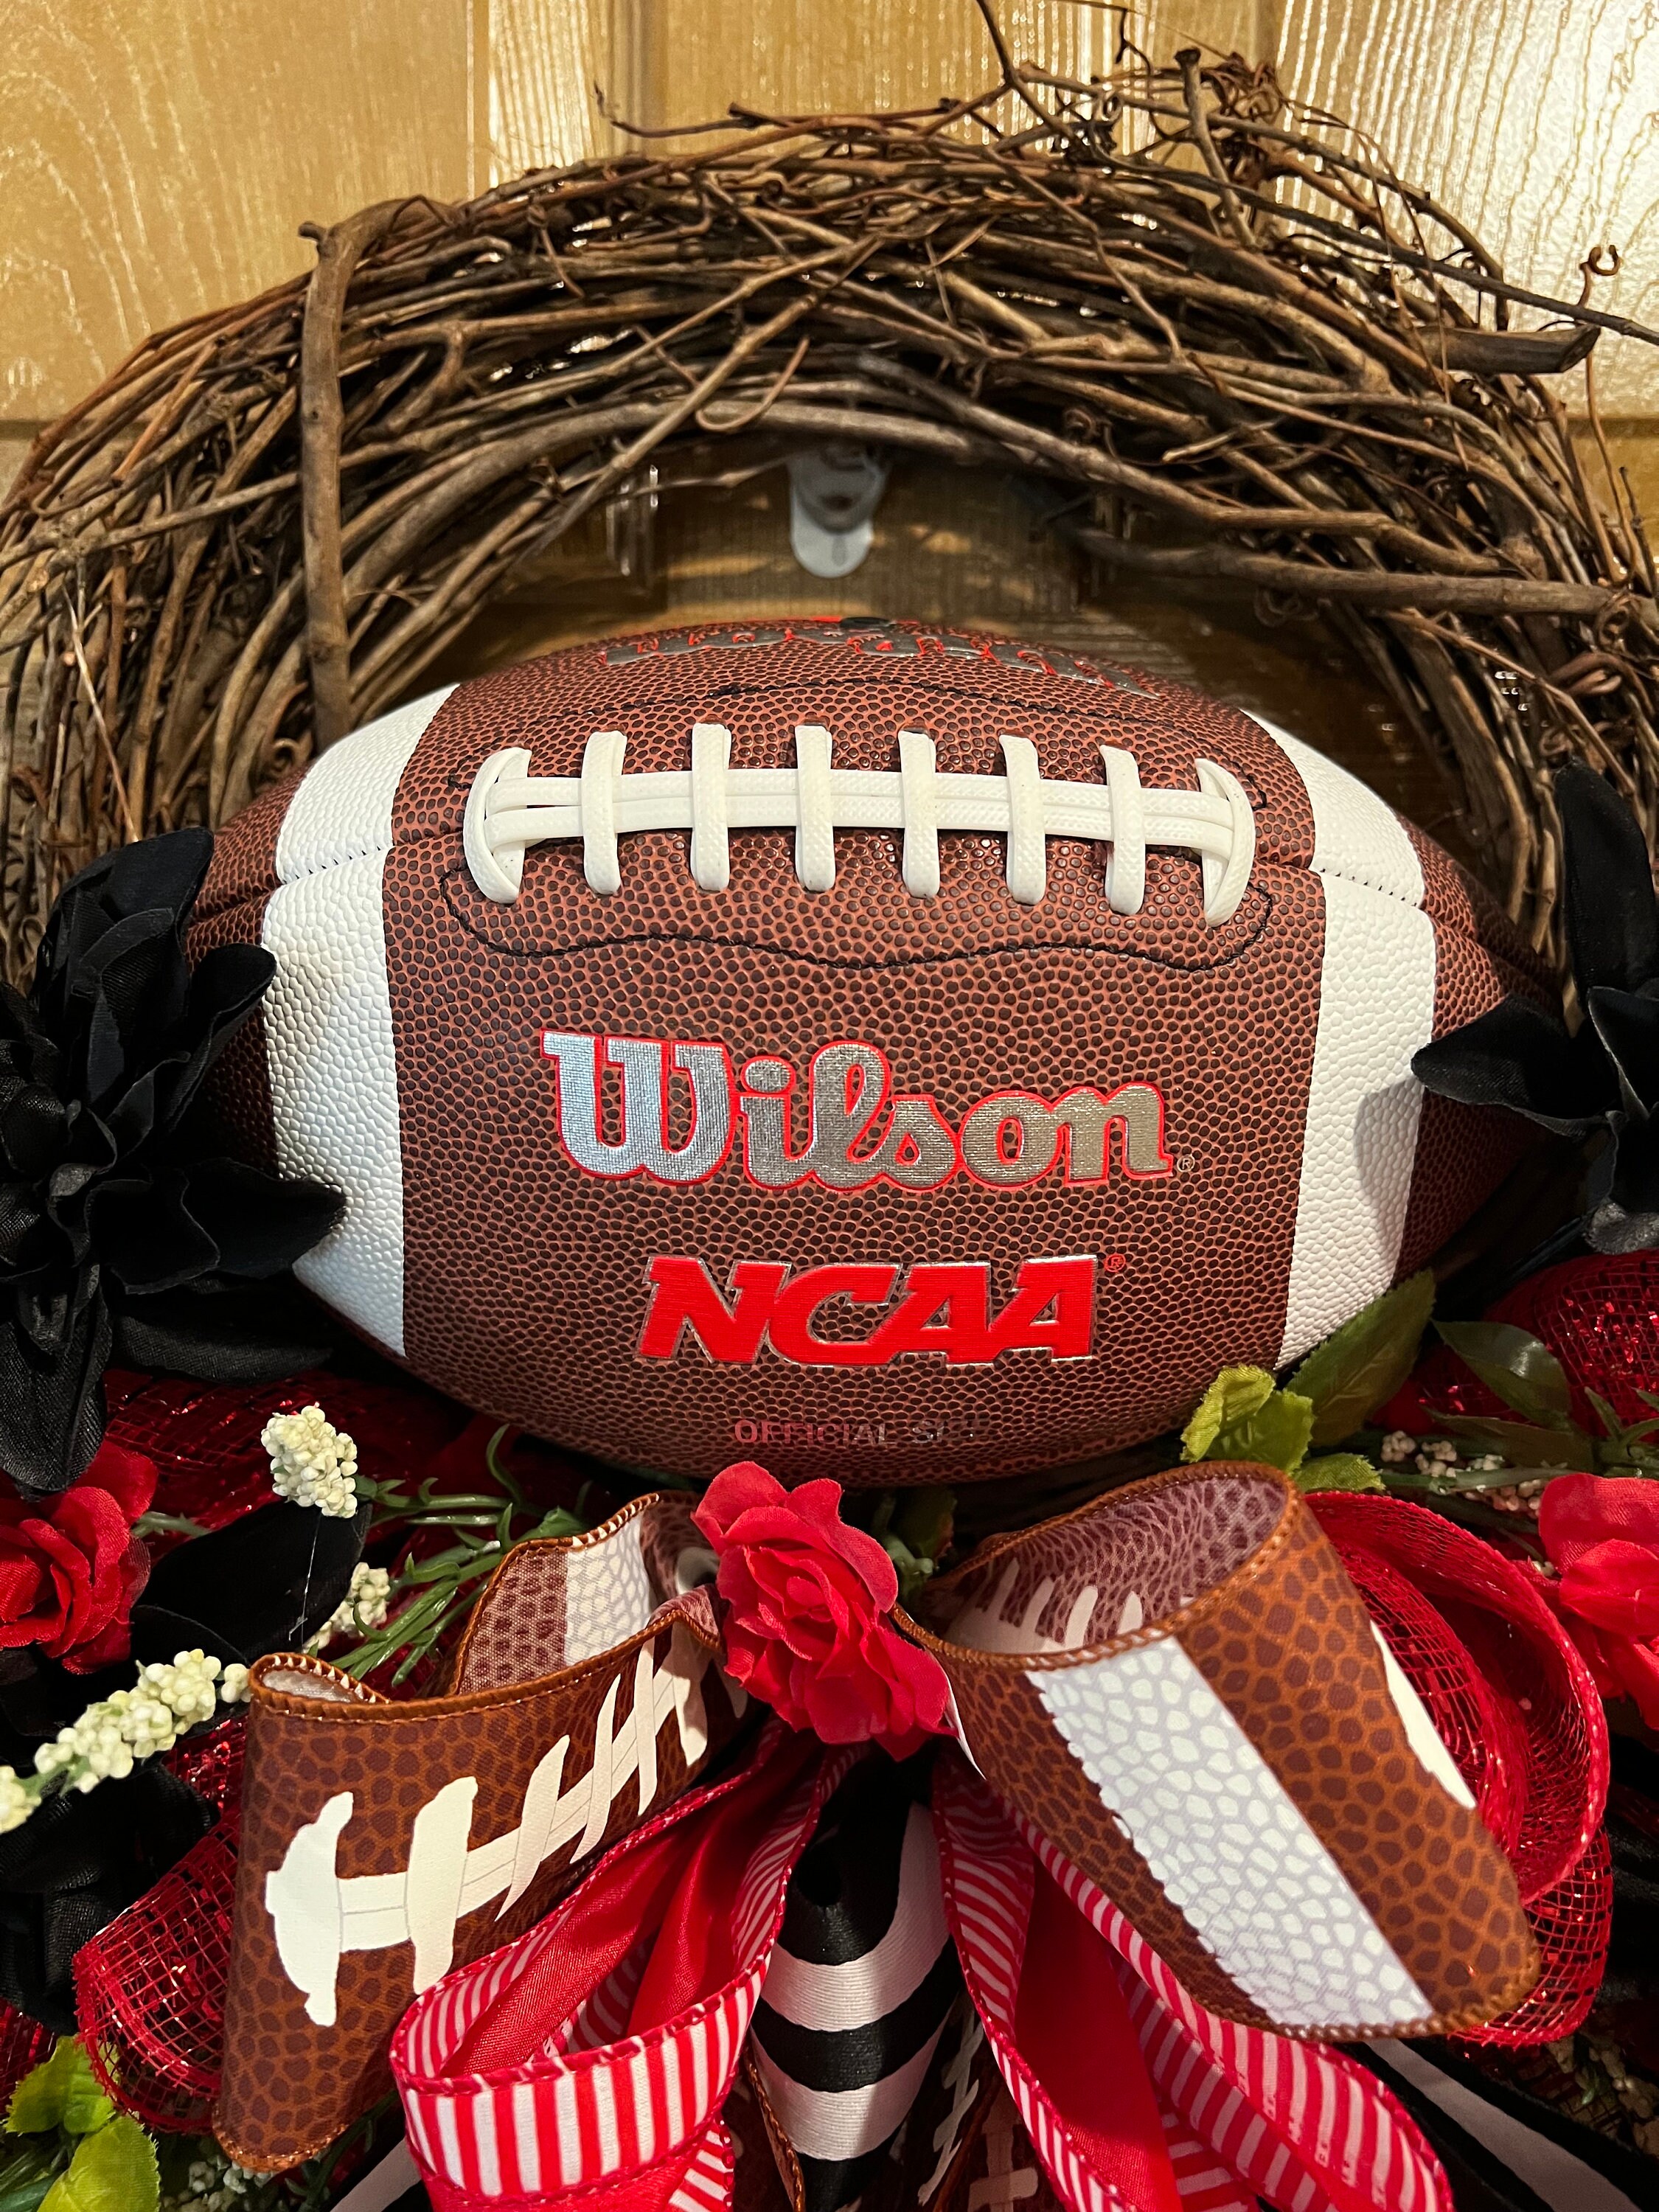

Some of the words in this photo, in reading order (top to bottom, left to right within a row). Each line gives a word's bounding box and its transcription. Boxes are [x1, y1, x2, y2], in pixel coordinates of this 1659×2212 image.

[541, 1031, 1174, 1192] Wilson
[635, 1253, 1098, 1368] NCAA
[734, 1419, 895, 1445] OFFICIAL
